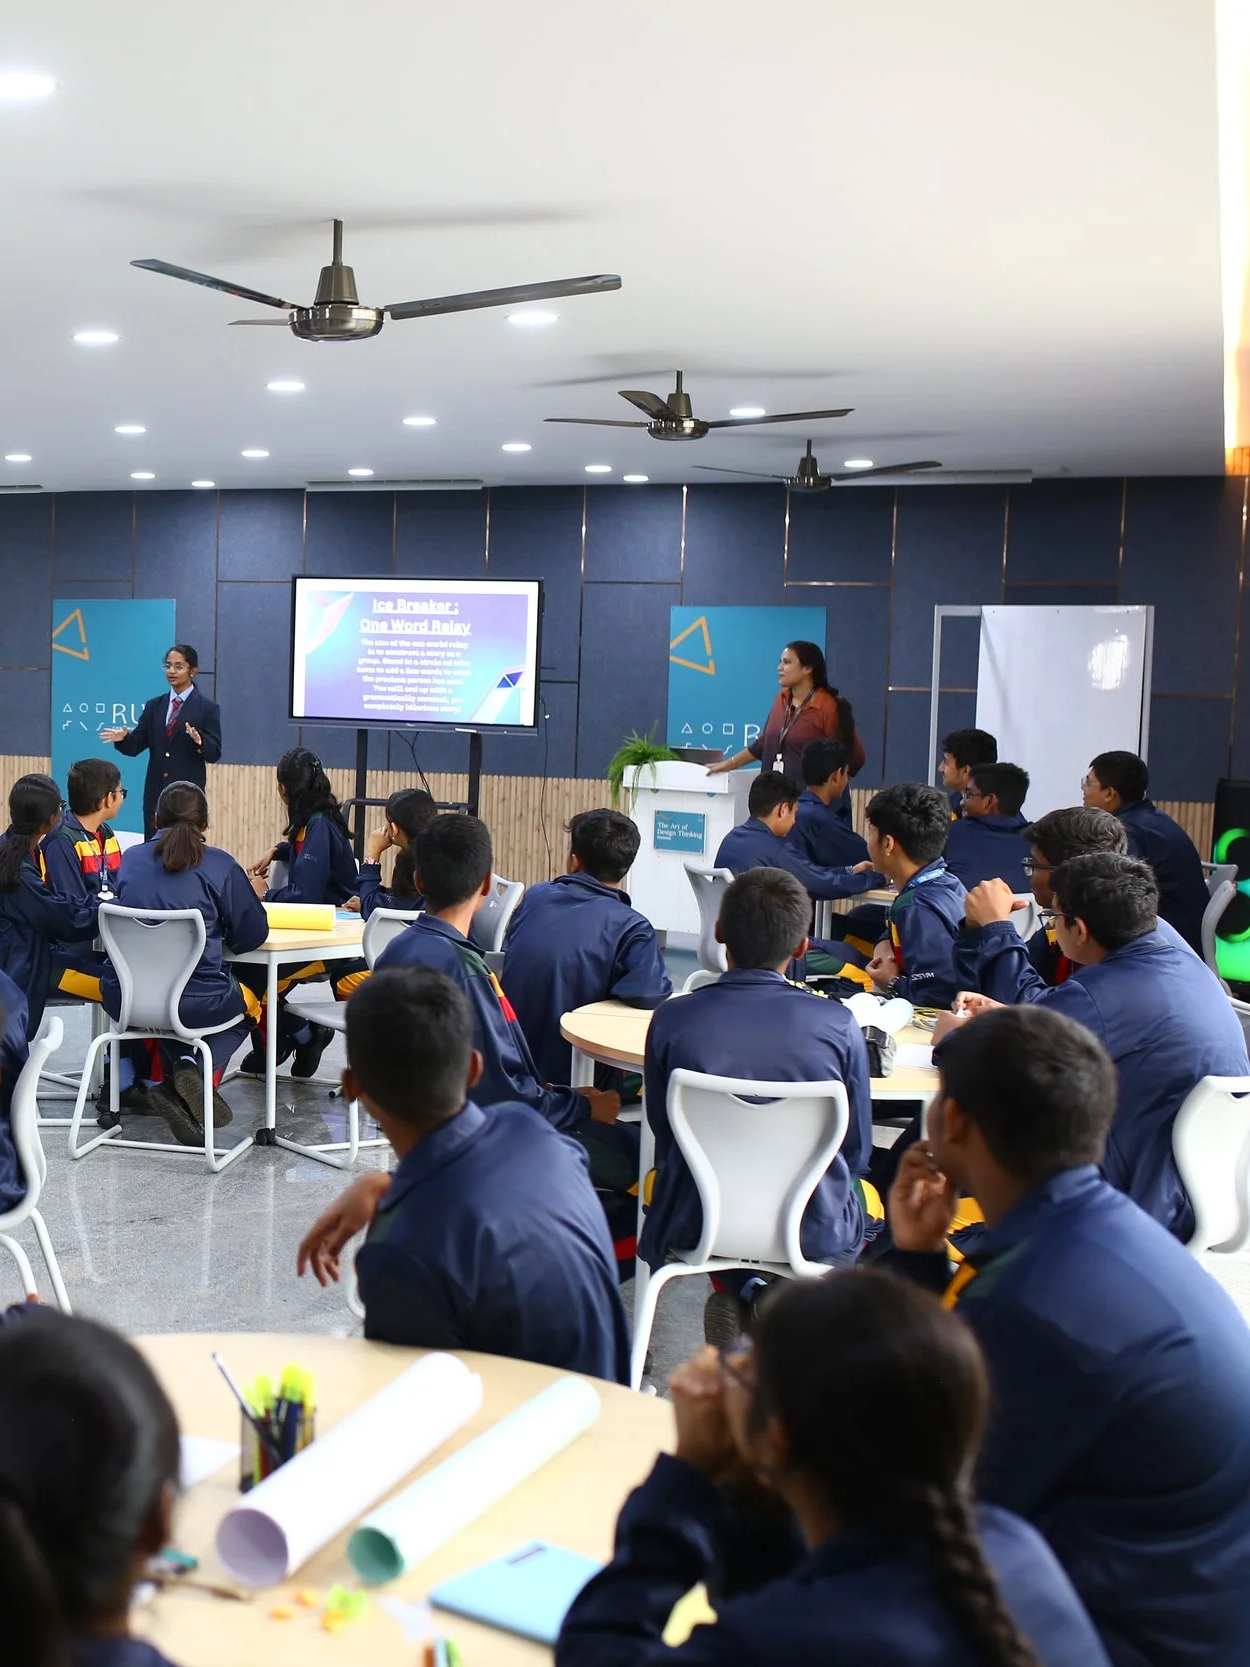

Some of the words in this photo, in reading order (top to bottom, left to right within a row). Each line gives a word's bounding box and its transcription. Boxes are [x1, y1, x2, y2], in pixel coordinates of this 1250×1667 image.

[373, 598, 394, 613] Ice
[397, 598, 452, 614] Breaker
[359, 618, 389, 633] One
[391, 619, 429, 634] Word
[432, 620, 471, 636] Relay
[657, 829, 676, 837] Design
[678, 831, 702, 840] Thinking
